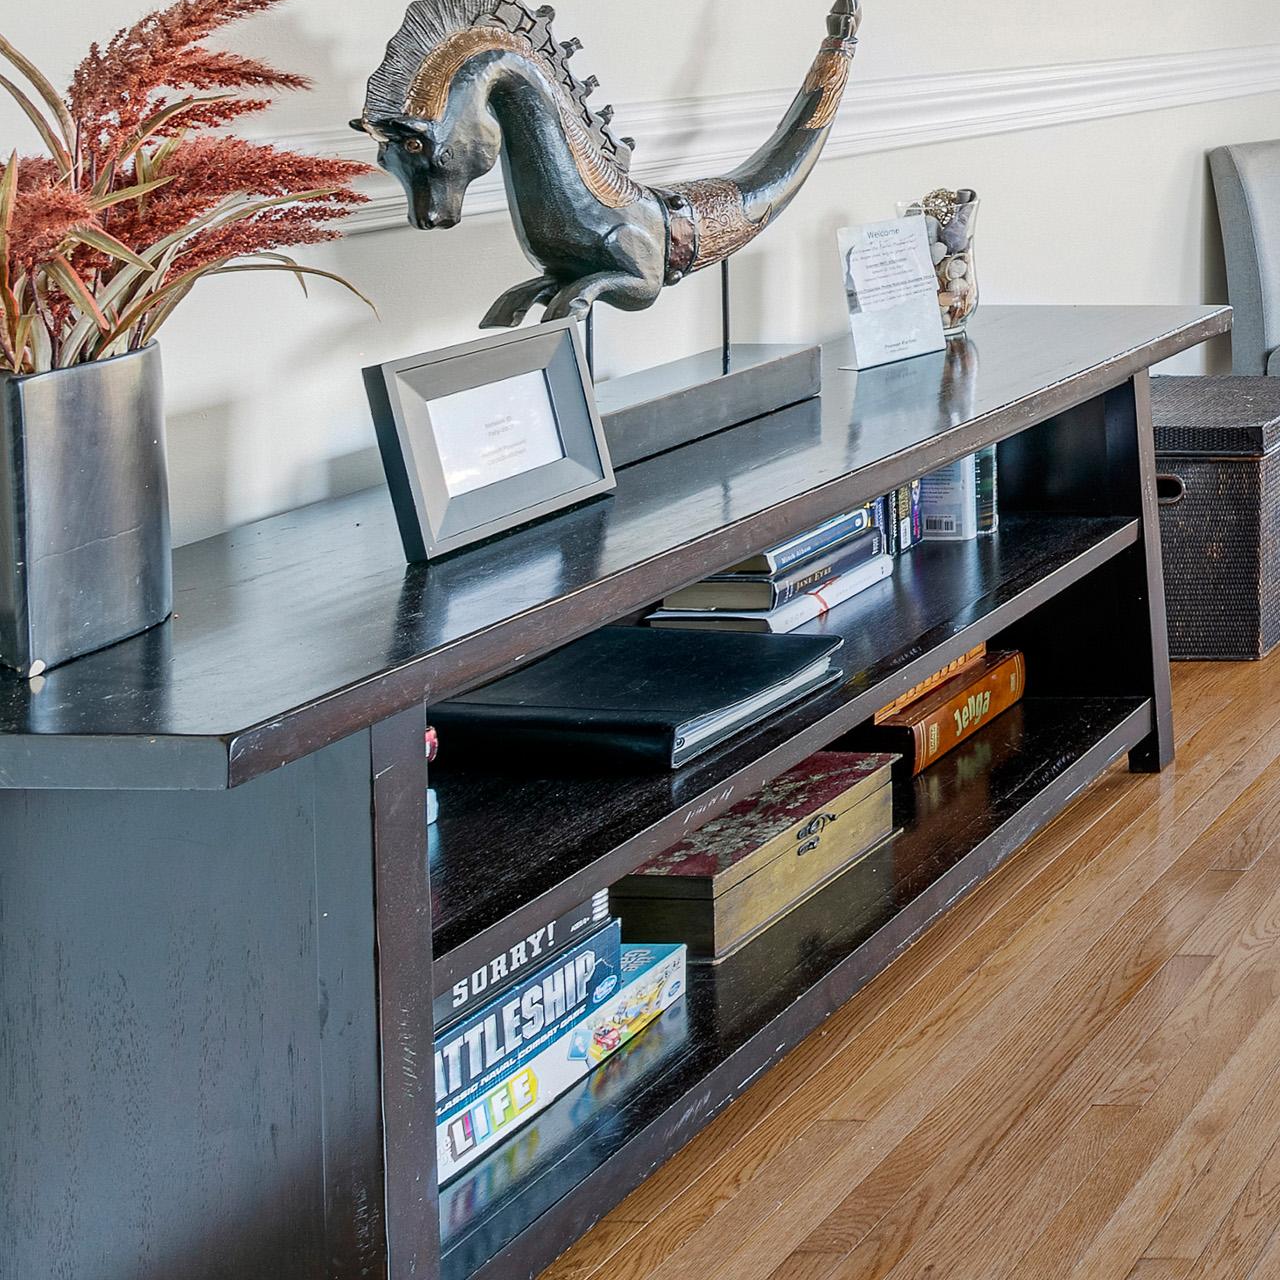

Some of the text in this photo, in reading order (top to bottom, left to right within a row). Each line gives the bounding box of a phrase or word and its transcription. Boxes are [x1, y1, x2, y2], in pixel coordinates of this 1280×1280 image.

[867, 228, 900, 239] Welcome
[954, 690, 992, 737] Jenga
[452, 920, 556, 1008] SORRY!
[434, 950, 597, 1104] ATTLESHIP
[435, 1004, 587, 1116] LASSIC NAVAL COMBAT GAME
[451, 1071, 534, 1156] LIFE
